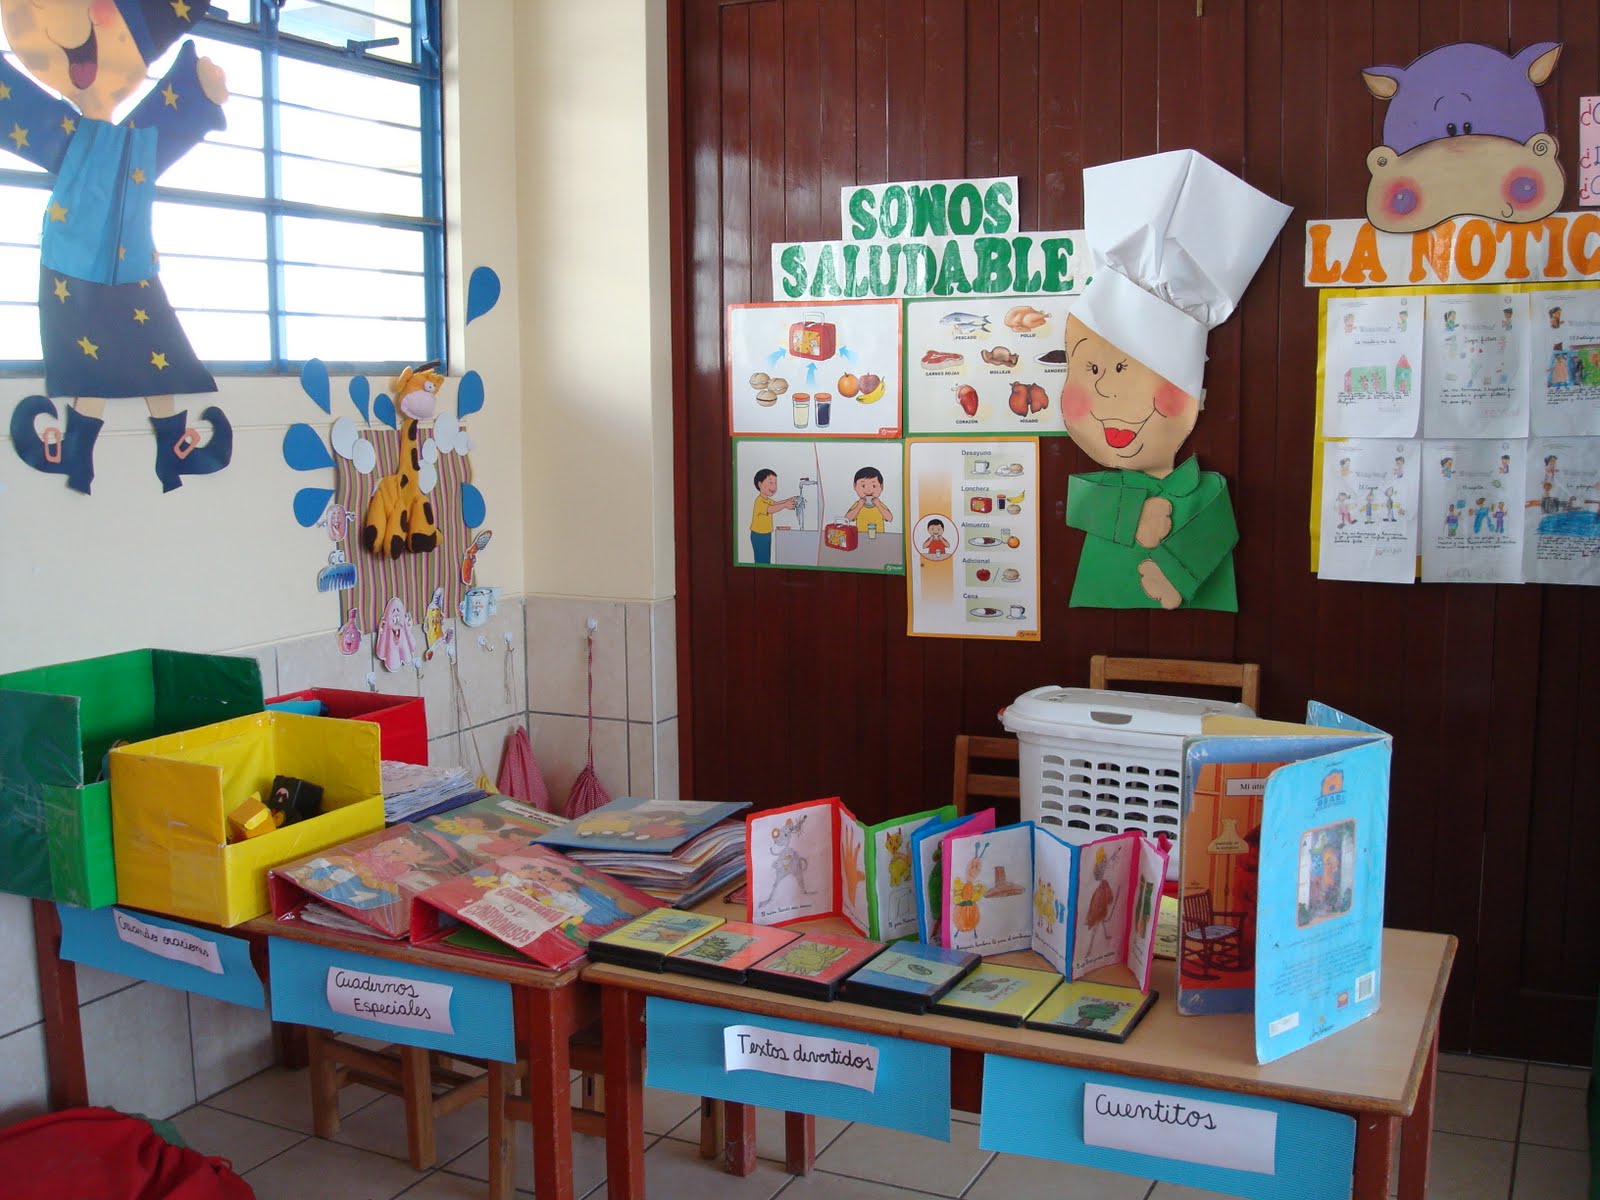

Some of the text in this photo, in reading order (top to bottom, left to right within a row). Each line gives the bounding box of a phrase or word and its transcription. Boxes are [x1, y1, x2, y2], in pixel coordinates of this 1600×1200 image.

[780, 236, 1093, 298] SALUDABLE
[1308, 223, 1388, 283] LA
[961, 449, 992, 457] Desayuno
[463, 904, 537, 943] COMPROMISOS
[336, 971, 419, 998] Cuadernos
[353, 998, 432, 1019] Especiales
[737, 1034, 874, 1071] Textos divertidos
[1095, 1093, 1217, 1130] Cuentitos
